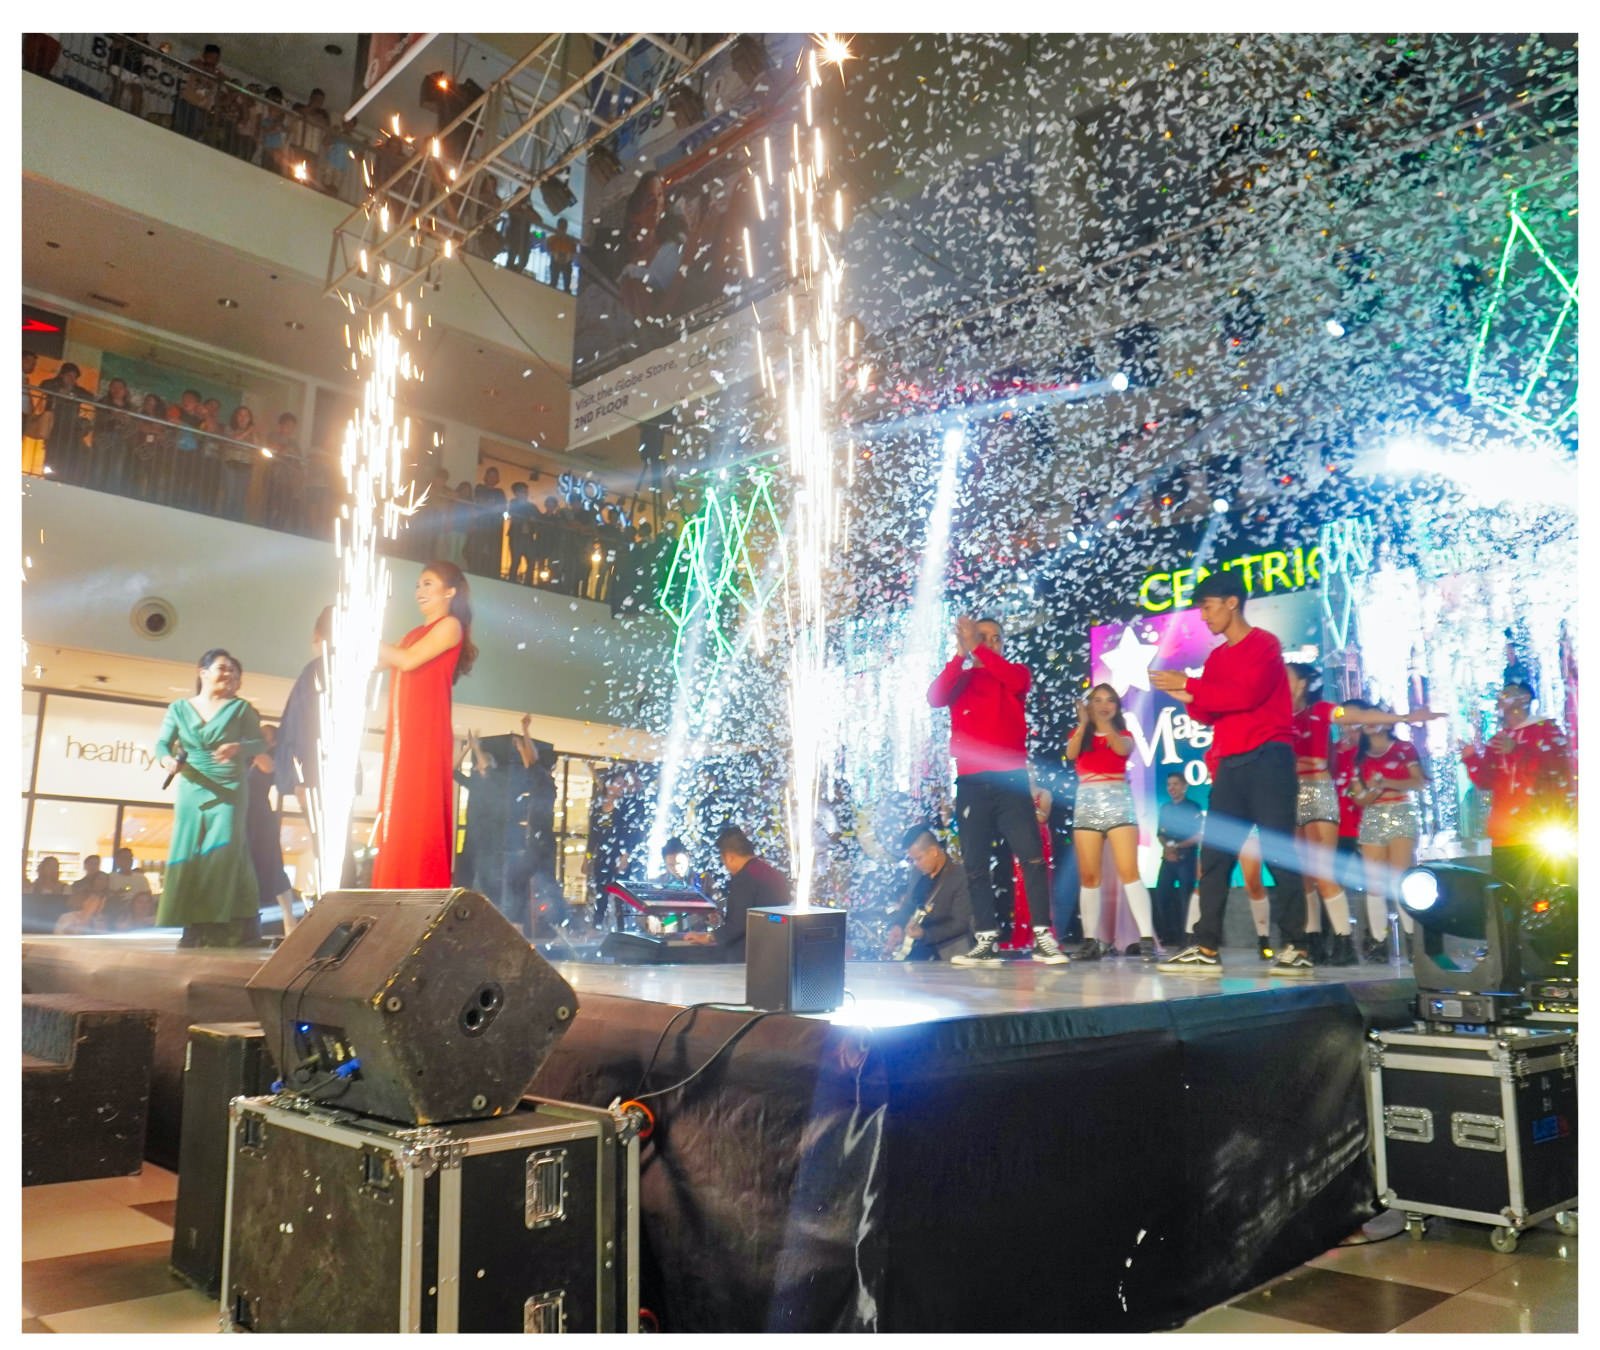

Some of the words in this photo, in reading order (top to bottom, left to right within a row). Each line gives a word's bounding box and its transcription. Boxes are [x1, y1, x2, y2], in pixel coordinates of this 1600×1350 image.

[575, 393, 596, 411] Visit
[614, 372, 644, 392] Globe
[645, 360, 678, 380] Store,
[574, 411, 594, 429] 2ND
[595, 395, 629, 417] FLOOR
[65, 735, 156, 772] healthy
